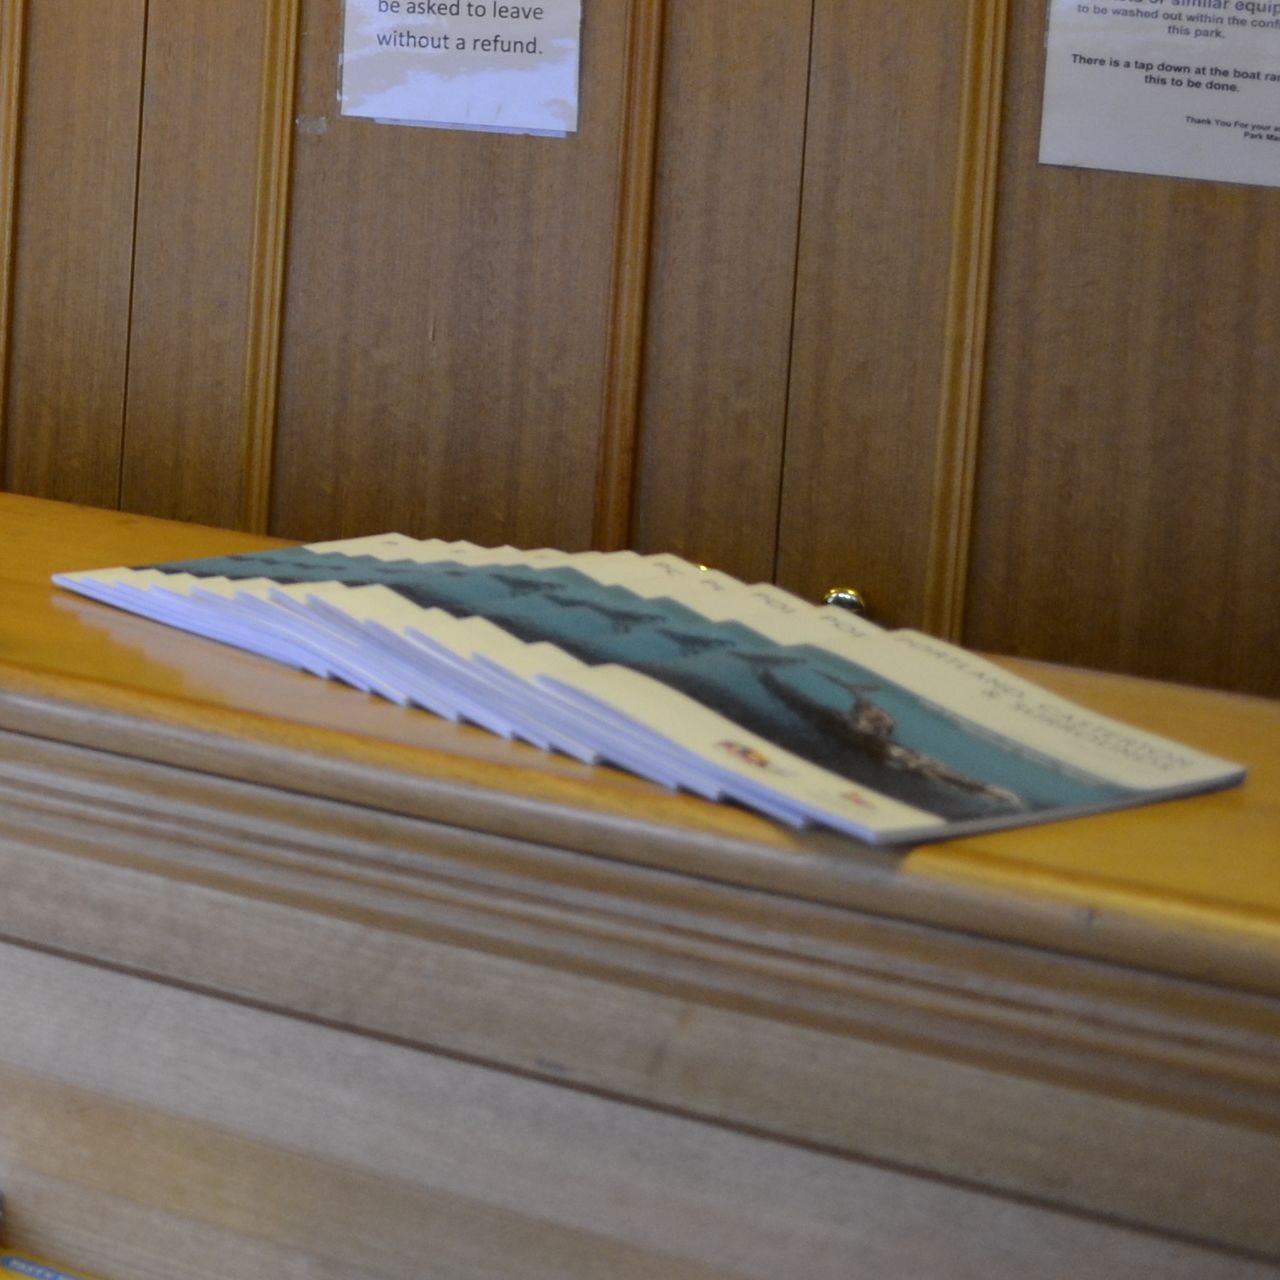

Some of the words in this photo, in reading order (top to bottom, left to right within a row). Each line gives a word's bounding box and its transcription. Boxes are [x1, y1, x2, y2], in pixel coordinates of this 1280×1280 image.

[467, 1, 486, 18] to
[492, 1, 544, 20] leave
[1077, 4, 1089, 13] to
[1093, 4, 1108, 15] be
[1111, 7, 1159, 19] washed
[1162, 11, 1182, 21] out
[1186, 13, 1224, 24] within
[1227, 16, 1247, 27] the
[1168, 25, 1190, 36] this
[1194, 27, 1225, 40] park.
[376, 30, 450, 50] without
[456, 36, 465, 50] a
[472, 34, 544, 55] refund.
[1072, 54, 1106, 66] There
[1109, 57, 1120, 67] is
[1123, 60, 1131, 68] a
[1134, 60, 1154, 72] tap
[1157, 62, 1191, 74] down
[1194, 66, 1206, 76] at
[1210, 67, 1229, 78] the
[1233, 69, 1261, 81] boat
[1144, 74, 1167, 86] this
[1171, 77, 1183, 87] to
[1187, 79, 1202, 89] be
[1205, 81, 1240, 92] done.
[1186, 115, 1212, 125] Thank
[1215, 118, 1232, 127] You
[1234, 120, 1248, 129] For
[1251, 123, 1271, 132] your
[1243, 131, 1263, 140] Park
